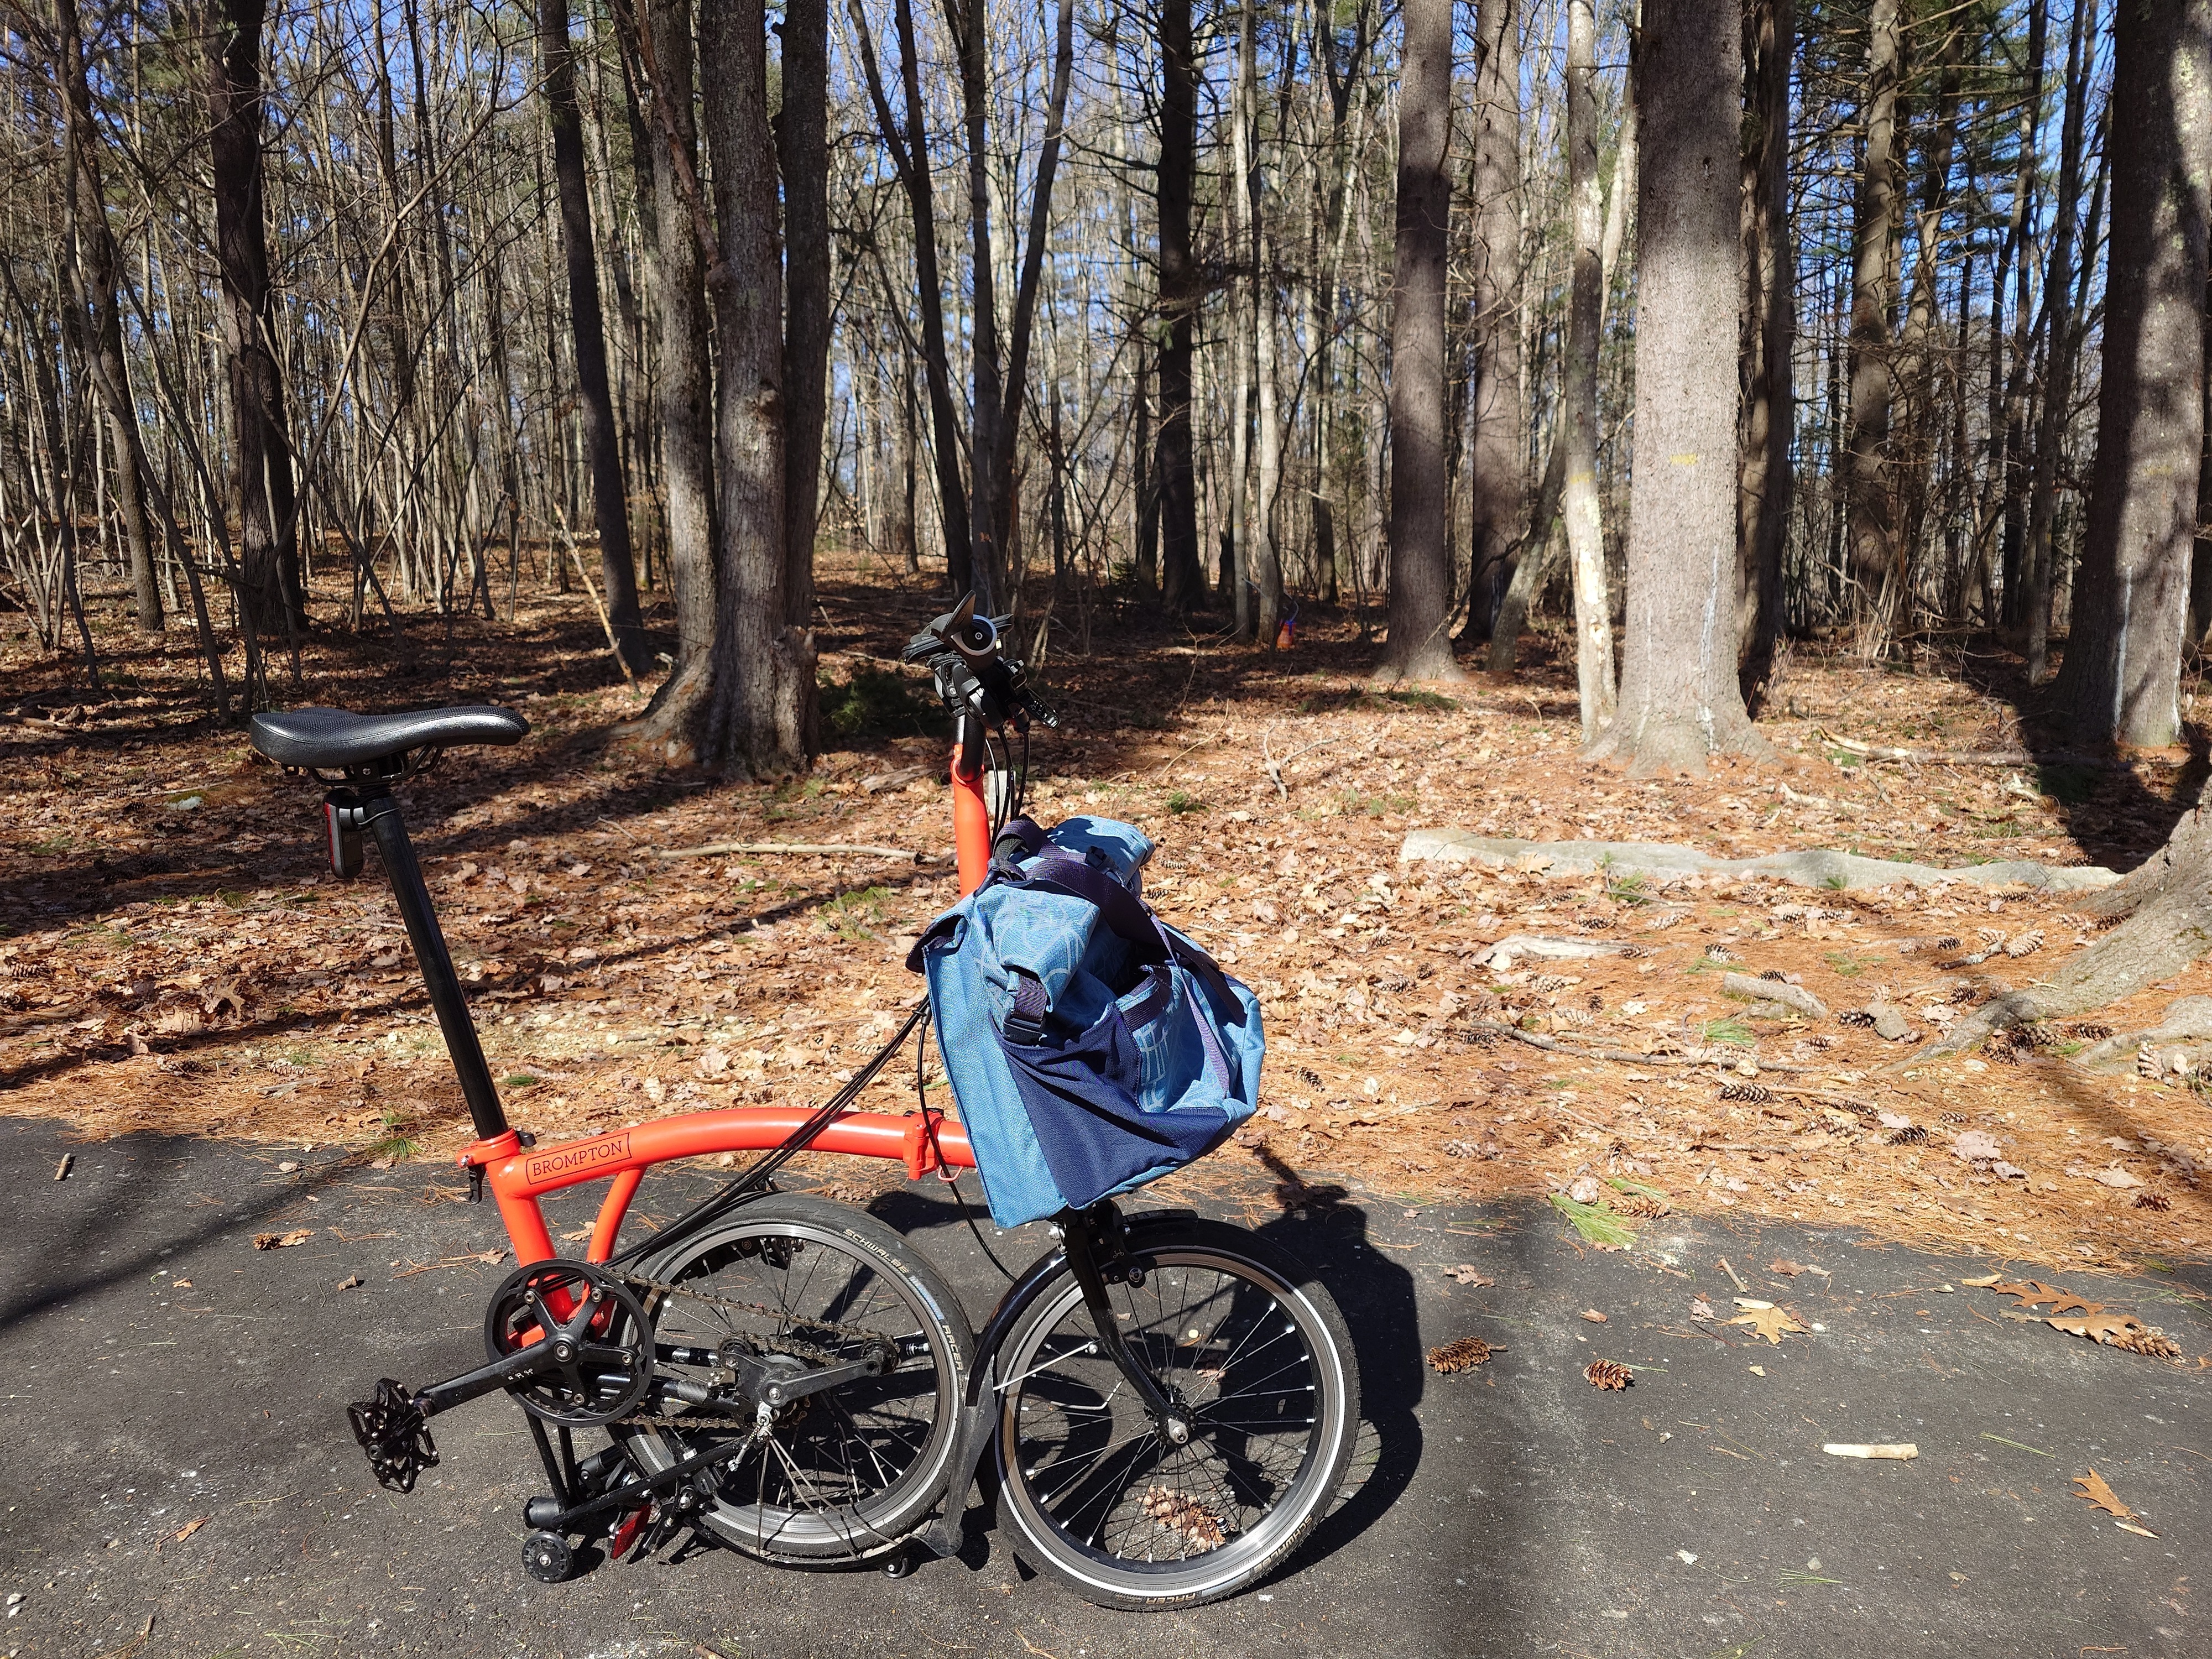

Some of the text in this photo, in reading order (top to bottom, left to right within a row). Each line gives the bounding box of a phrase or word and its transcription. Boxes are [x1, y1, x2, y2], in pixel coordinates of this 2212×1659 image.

[533, 1140, 622, 1176] BROMPTON
[843, 1229, 909, 1274] SCHWALBE
[942, 1325, 963, 1370] RACER
[1254, 1514, 1312, 1572] SCHWALBE
[1146, 1592, 1196, 1604] RACER
